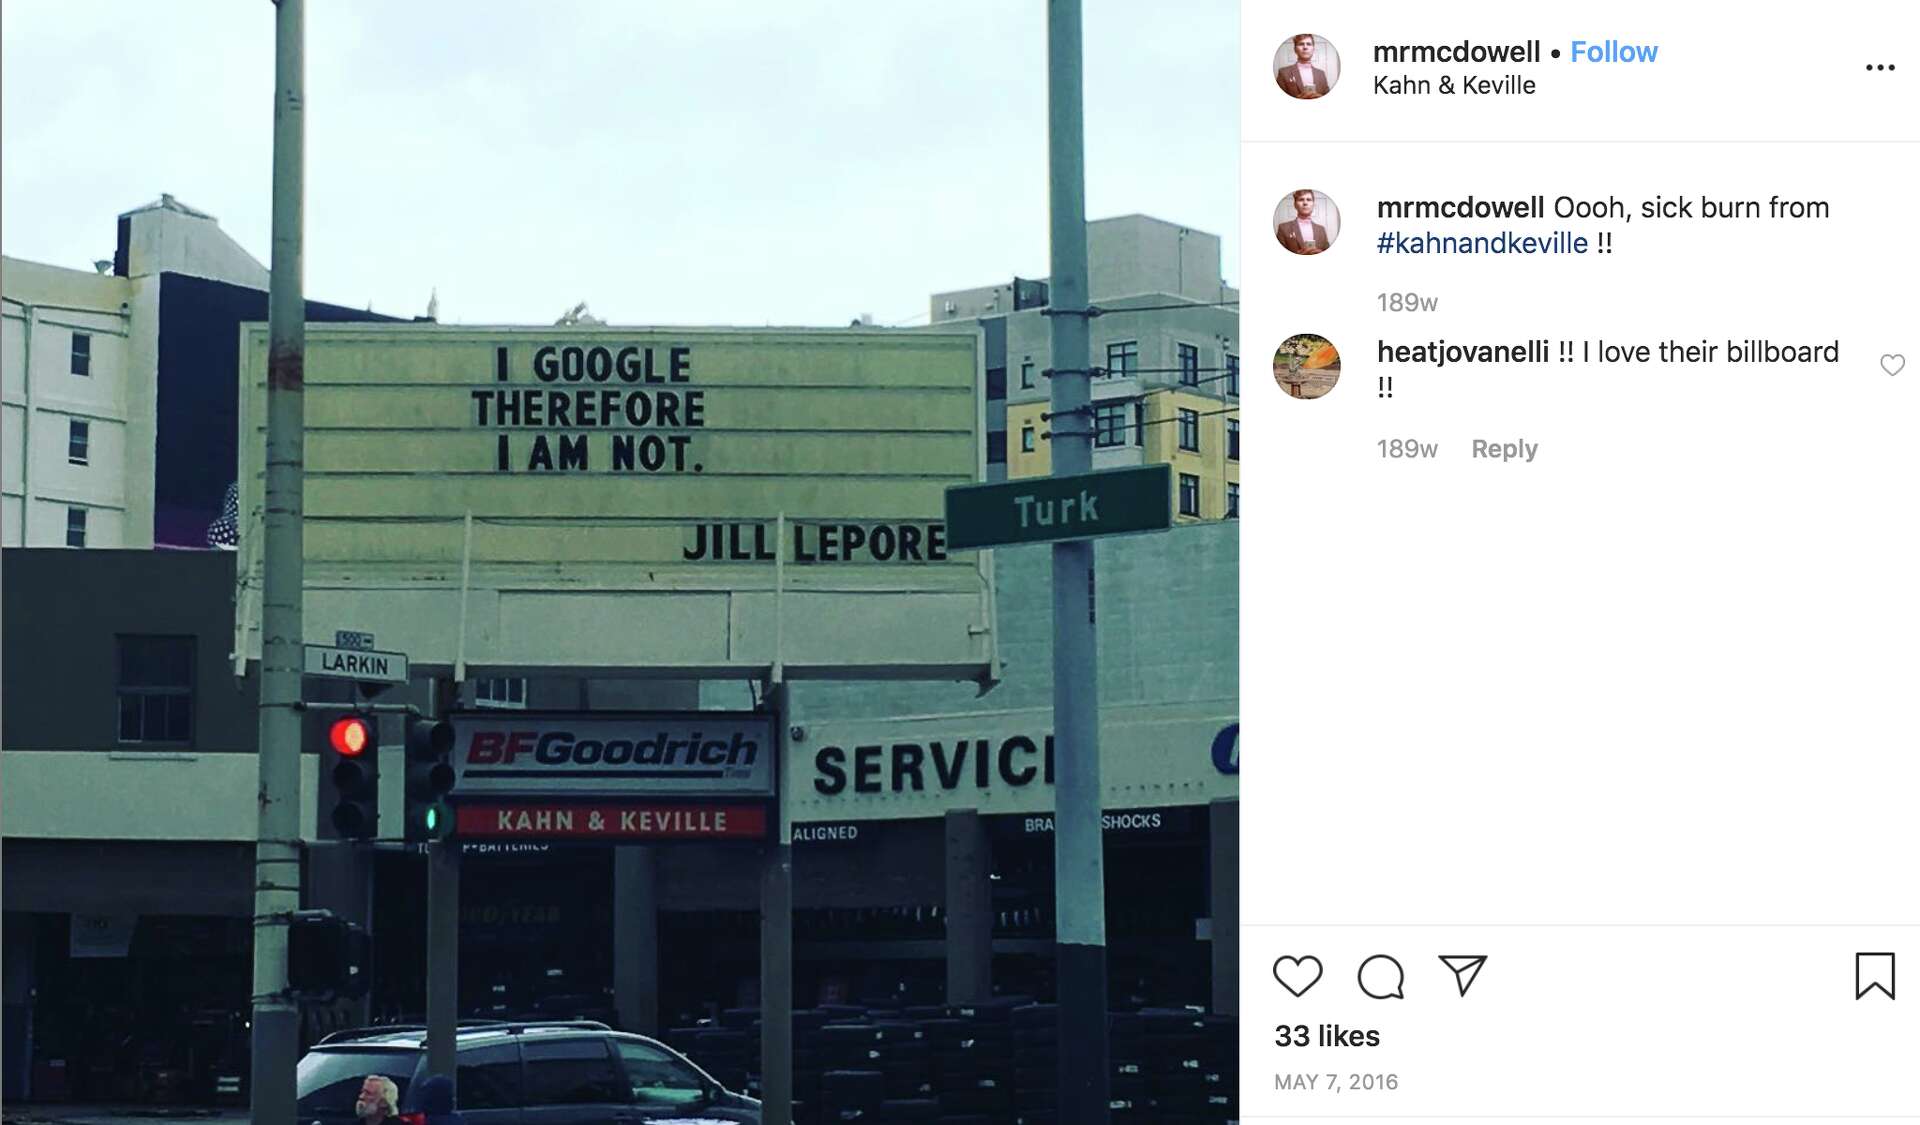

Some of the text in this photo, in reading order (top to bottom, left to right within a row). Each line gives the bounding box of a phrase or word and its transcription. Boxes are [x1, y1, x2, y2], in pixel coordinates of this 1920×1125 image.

[497, 346, 690, 383] I GOOGLE
[471, 390, 705, 426] THEREFORE
[498, 434, 703, 472] I AM NOT.
[1014, 489, 1099, 528] Turk
[683, 524, 947, 561] JILL LEPORE
[322, 652, 388, 675] LARKIN
[466, 731, 757, 766] BFGoodrich
[498, 811, 728, 832] KAHN & KEVILLE
[792, 825, 859, 841] ALIGNED
[1024, 812, 1161, 833] BRA SHOCKS
